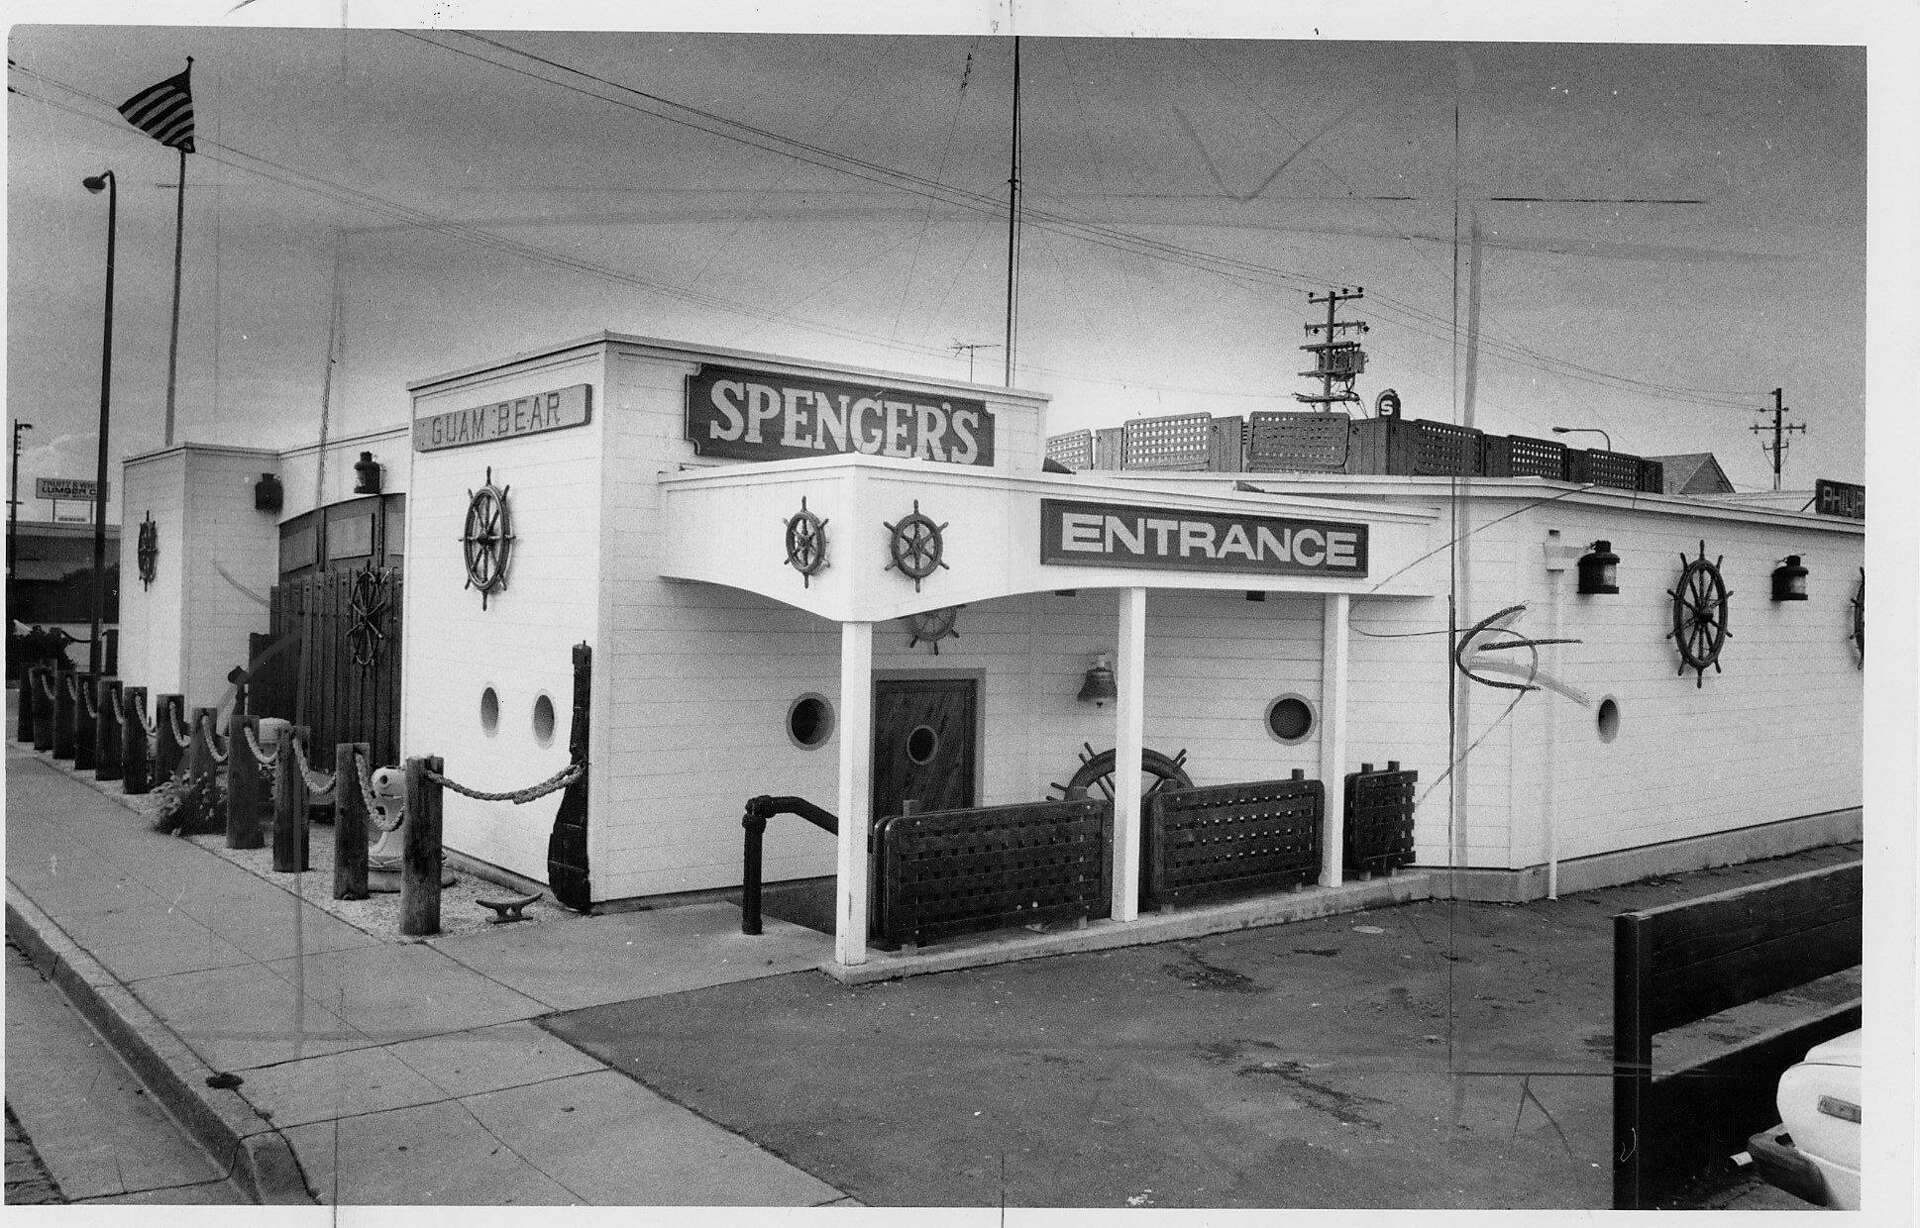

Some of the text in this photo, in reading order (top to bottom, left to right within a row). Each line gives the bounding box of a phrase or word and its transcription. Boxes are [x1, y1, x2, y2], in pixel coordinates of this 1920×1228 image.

[432, 392, 561, 445] GUAM BEAR
[709, 379, 979, 465] SPENGER'S
[1380, 399, 1394, 416] S
[1061, 512, 1358, 567] ENTRANCE
